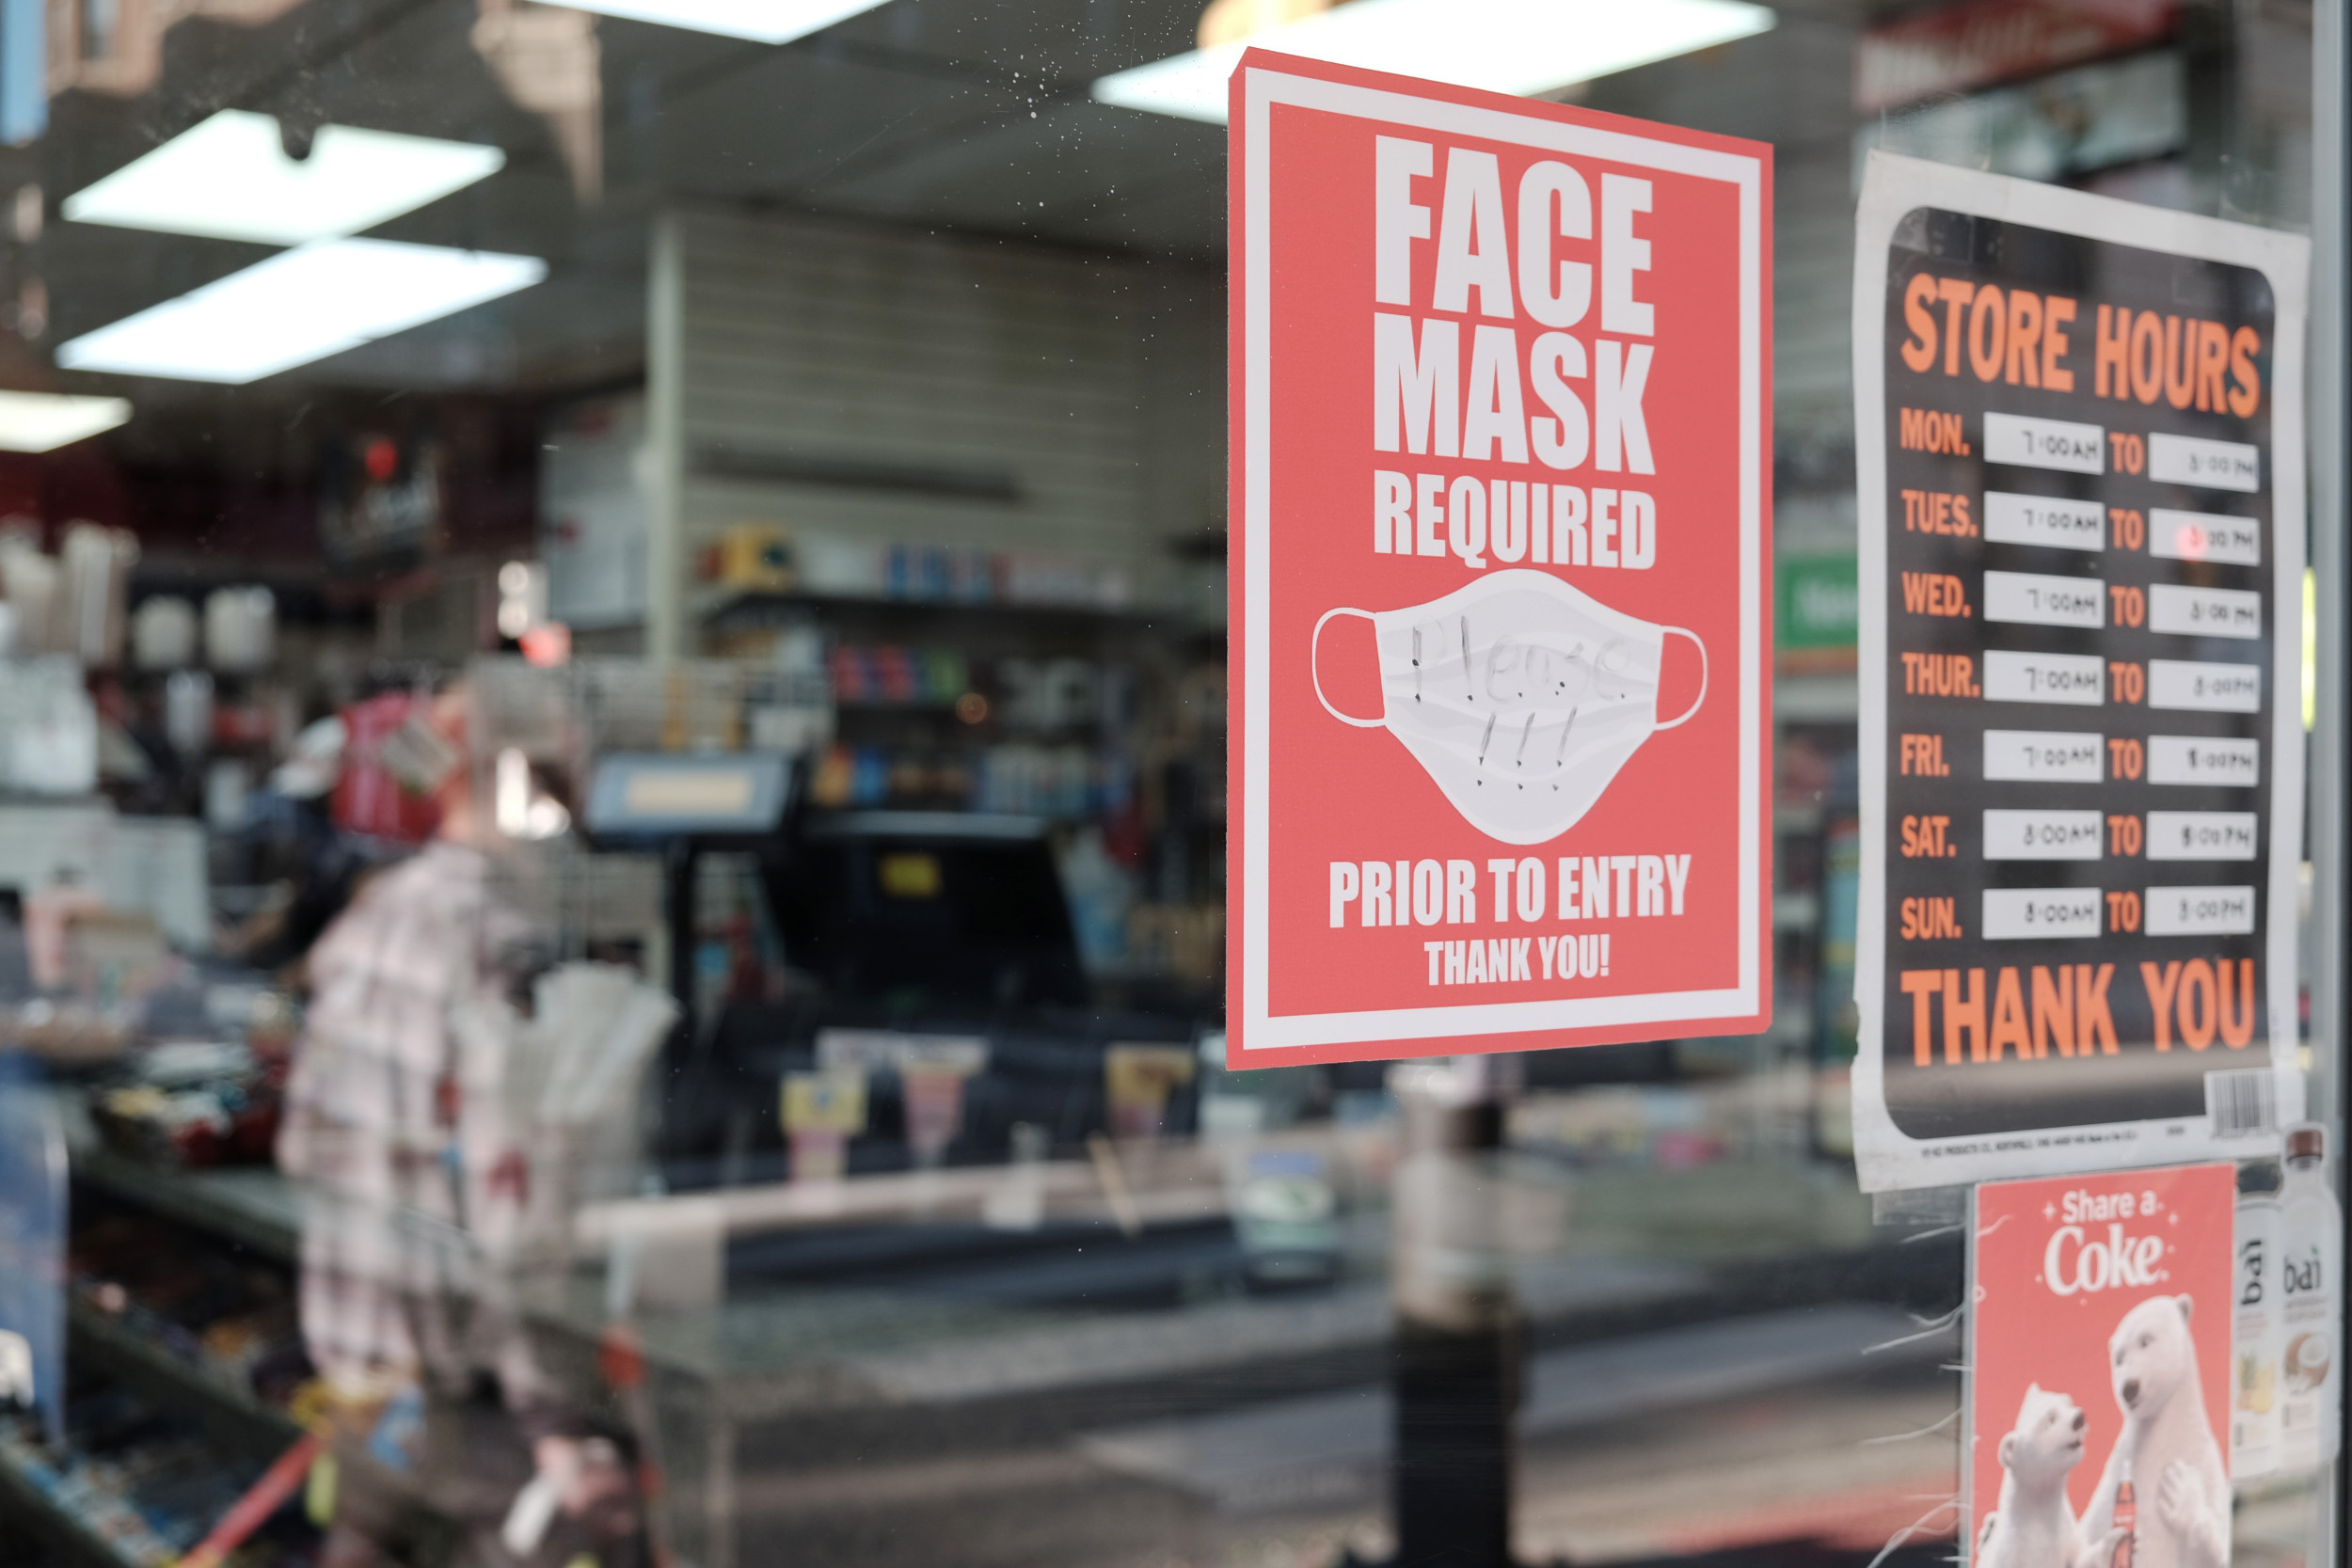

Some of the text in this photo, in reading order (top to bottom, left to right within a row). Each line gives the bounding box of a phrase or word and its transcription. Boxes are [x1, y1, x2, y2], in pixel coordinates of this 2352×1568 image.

[1375, 134, 1656, 337] FACE
[1900, 273, 2261, 419] STORE HOURS
[1374, 312, 1656, 475] MASK
[1900, 407, 1970, 457] MON.
[2108, 431, 2145, 476] TO
[1374, 469, 1656, 570] REQUIRED
[1900, 488, 1979, 538] TUES.
[2108, 507, 2145, 551] TO
[1901, 571, 1972, 618] WED.
[2108, 585, 2145, 628] TO
[1413, 615, 1632, 704] Please
[1900, 652, 1980, 698] THUR.
[2108, 661, 2145, 705] TO
[1900, 733, 1950, 777] FRI.
[2107, 738, 2144, 781] TO
[1900, 815, 1957, 858] SAT.
[2106, 815, 2143, 857] TO
[1329, 853, 1692, 928] PRIOR TO ENTRY
[1900, 895, 1963, 941] SUN.
[2106, 891, 2141, 934] TO
[1423, 933, 1611, 987] THANK YOU!
[1900, 957, 2256, 1068] THANK YOU
[2061, 1188, 2157, 1224] Share a
[2043, 1222, 2165, 1297] Coke
[2239, 1238, 2263, 1307] bai
[2283, 1243, 2321, 1294] bai
